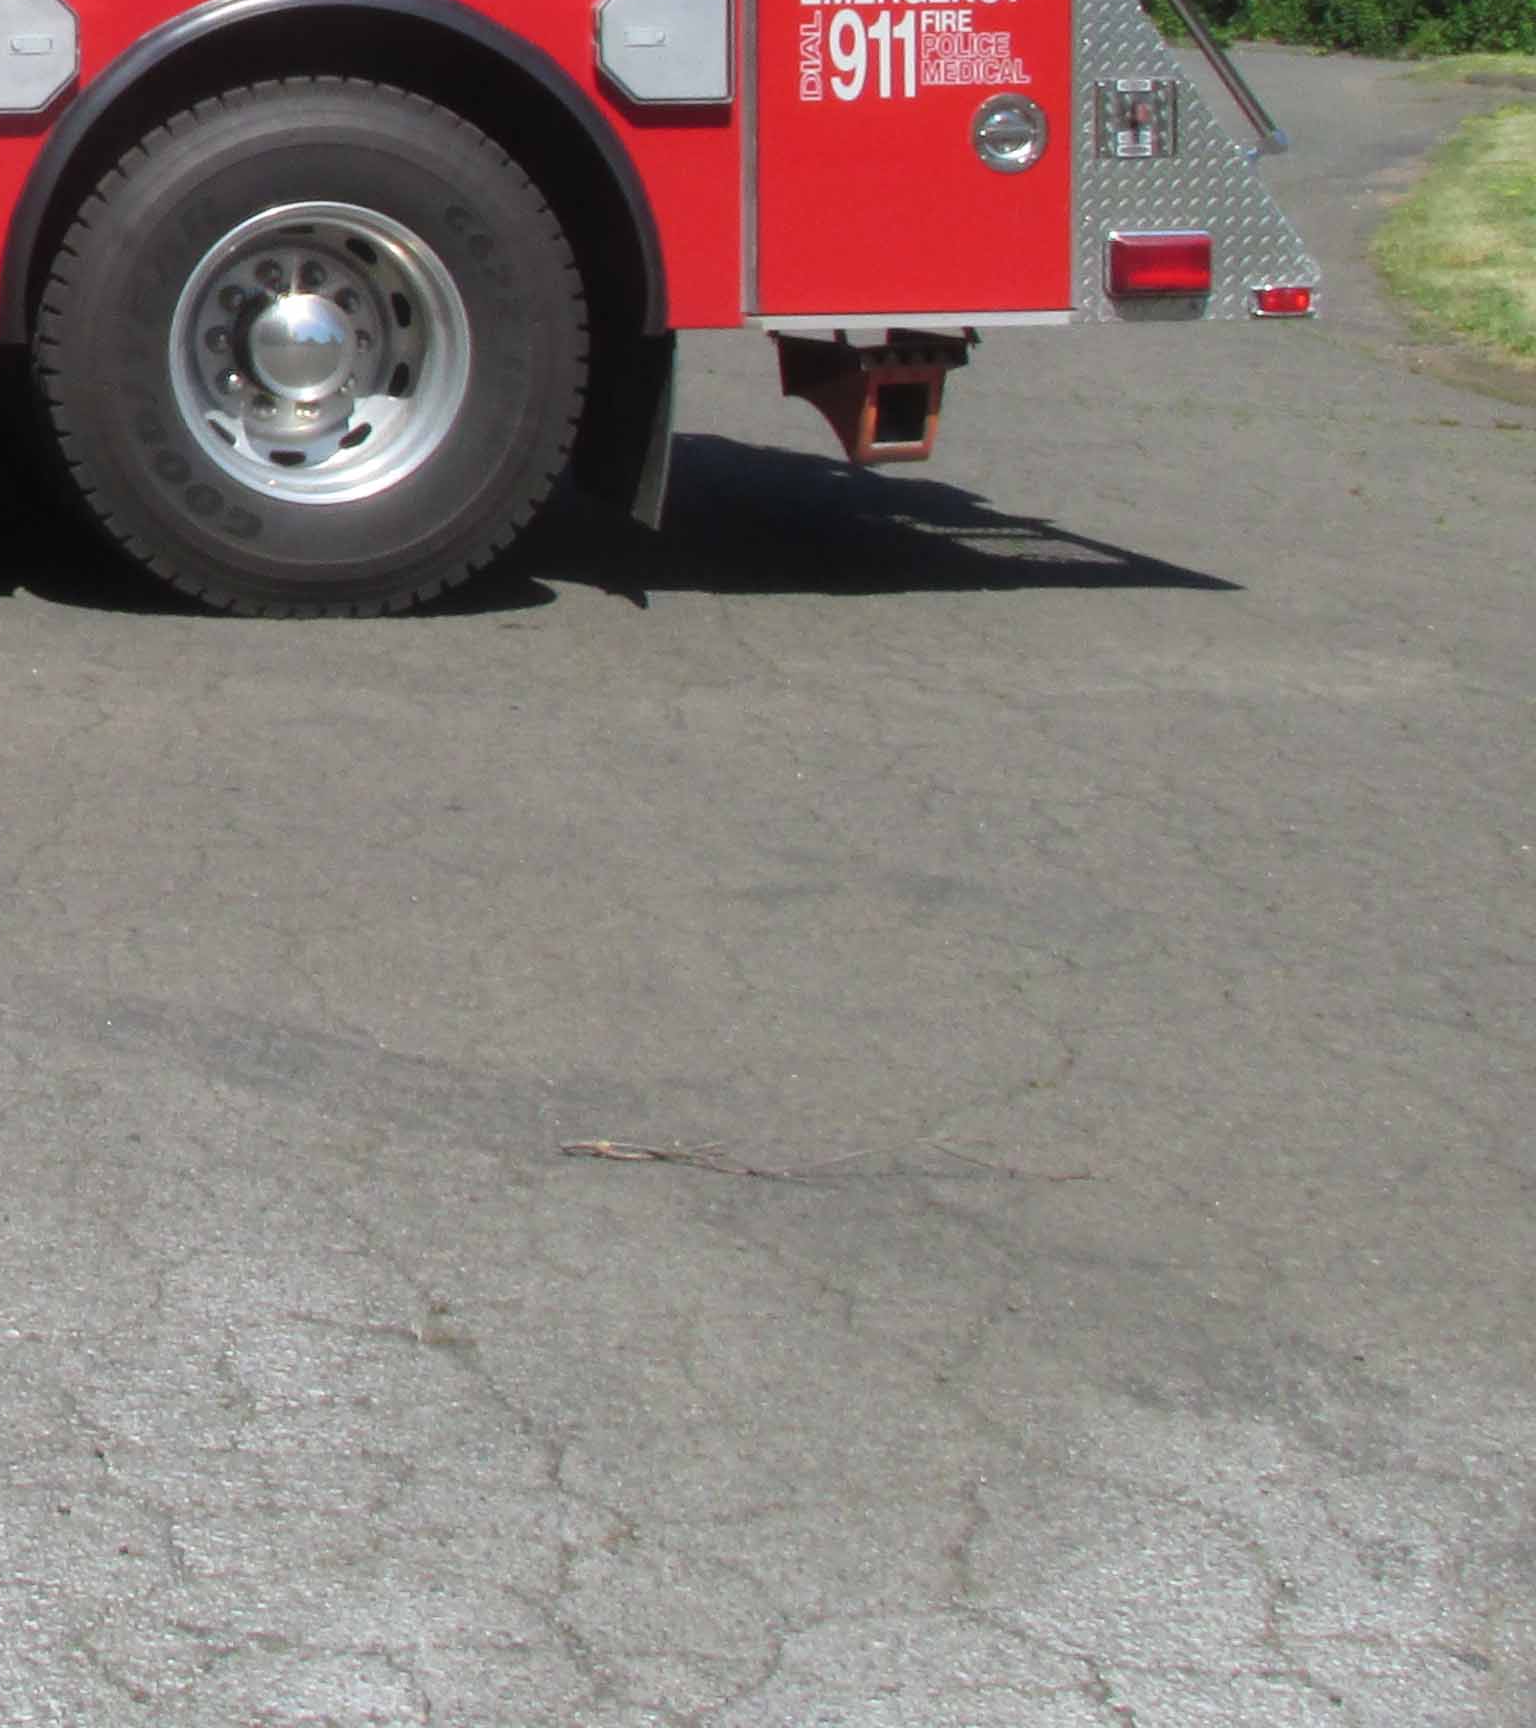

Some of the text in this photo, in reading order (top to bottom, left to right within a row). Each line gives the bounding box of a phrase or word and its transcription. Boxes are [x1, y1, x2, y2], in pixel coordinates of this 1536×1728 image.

[920, 9, 973, 32] FIRE
[799, 9, 823, 102] DIAL
[828, 8, 916, 102] 911
[920, 33, 1010, 58] POLICE
[920, 60, 1031, 85] MEDICAL
